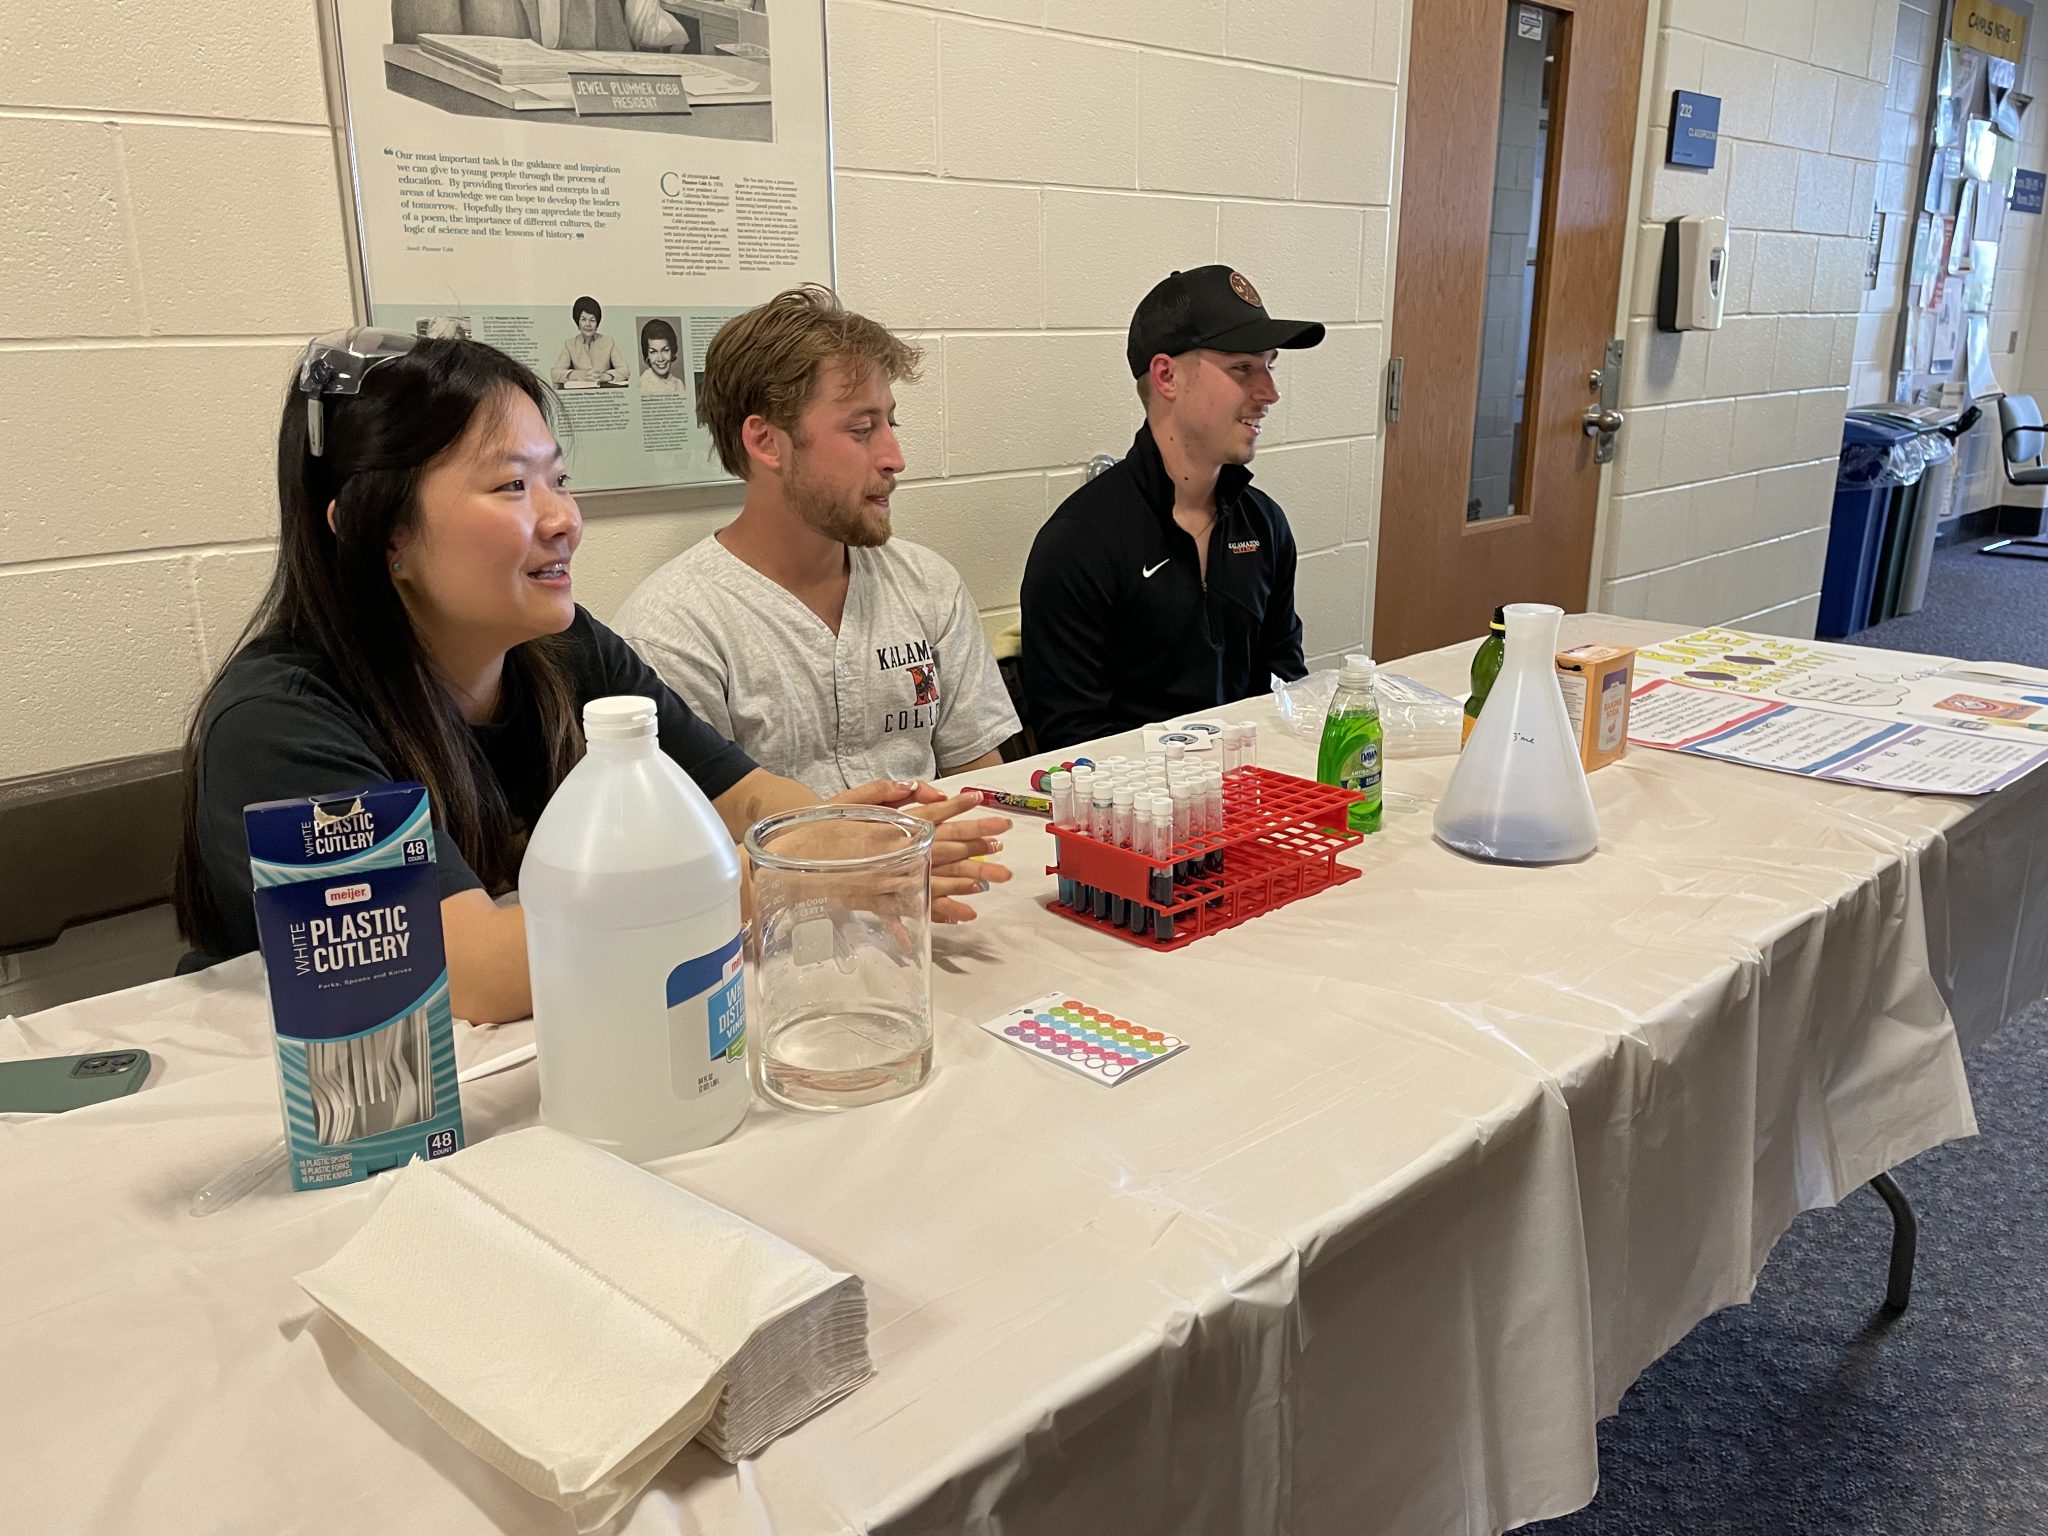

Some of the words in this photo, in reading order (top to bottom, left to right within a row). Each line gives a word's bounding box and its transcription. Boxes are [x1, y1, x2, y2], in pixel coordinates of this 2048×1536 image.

[576, 80, 609, 96] JEWEL
[611, 82, 655, 97] PLUMMER
[657, 84, 680, 97] COBB
[612, 96, 658, 110] PRESIDENT
[1680, 104, 1693, 118] 232
[439, 153, 480, 165] important
[483, 157, 500, 165] task
[512, 159, 524, 167] the
[527, 160, 561, 170] guidance
[564, 163, 579, 171] and
[581, 164, 621, 174] inspiration
[430, 165, 448, 175] give
[462, 168, 487, 178] young
[490, 170, 517, 180] people
[520, 172, 551, 182] through
[553, 173, 565, 181] the
[567, 175, 596, 184] process
[598, 176, 605, 184] of
[398, 175, 443, 186] education.
[449, 178, 460, 189] By
[463, 180, 503, 191] providing
[505, 182, 537, 191] theories
[540, 184, 554, 192] and
[556, 186, 589, 196] concepts
[600, 187, 610, 195] all
[426, 189, 435, 197] of
[437, 190, 482, 201] knowledge
[516, 194, 535, 203] hope
[537, 195, 545, 203] to
[547, 197, 577, 207] develop
[579, 198, 591, 206] the
[593, 198, 620, 207] leaders
[400, 200, 410, 208] of
[412, 202, 457, 210] tomorrow.
[464, 203, 502, 214] Hopefully
[505, 206, 522, 215] they
[541, 208, 581, 218] appreciate
[583, 209, 595, 217] the
[597, 210, 621, 220] beauty
[402, 212, 411, 221] of
[421, 215, 447, 224] poem,
[450, 215, 463, 223] the
[465, 215, 511, 226] importance
[513, 217, 522, 225] of
[523, 218, 556, 227] different
[594, 220, 607, 228] the
[404, 224, 424, 235] logic
[427, 225, 436, 234] of
[438, 226, 469, 234] science
[488, 228, 502, 236] the
[505, 228, 534, 237] lessons
[536, 229, 544, 237] of
[313, 813, 374, 838] PLASTIC
[302, 821, 312, 857] WHITE
[314, 832, 375, 855] CUTLERY
[406, 842, 425, 856] 48
[407, 854, 425, 863] COUNT
[330, 886, 367, 902] meijer
[310, 905, 408, 947] PLASTIC
[290, 923, 311, 976] WHITE
[313, 932, 410, 973] CUTLERY
[318, 981, 342, 990] Forks,
[344, 976, 371, 986] Spoons
[373, 972, 387, 980] and
[388, 967, 413, 976] Knives
[431, 1132, 452, 1149] 48
[306, 1157, 330, 1167] PLASTIC
[330, 1152, 353, 1164] SPOONS
[432, 1147, 452, 1157] COUNT
[307, 1165, 330, 1175] PLASTIC
[331, 1161, 349, 1172] FORKS
[308, 1173, 332, 1183] PLASTIC
[332, 1168, 353, 1180] KNIVES
